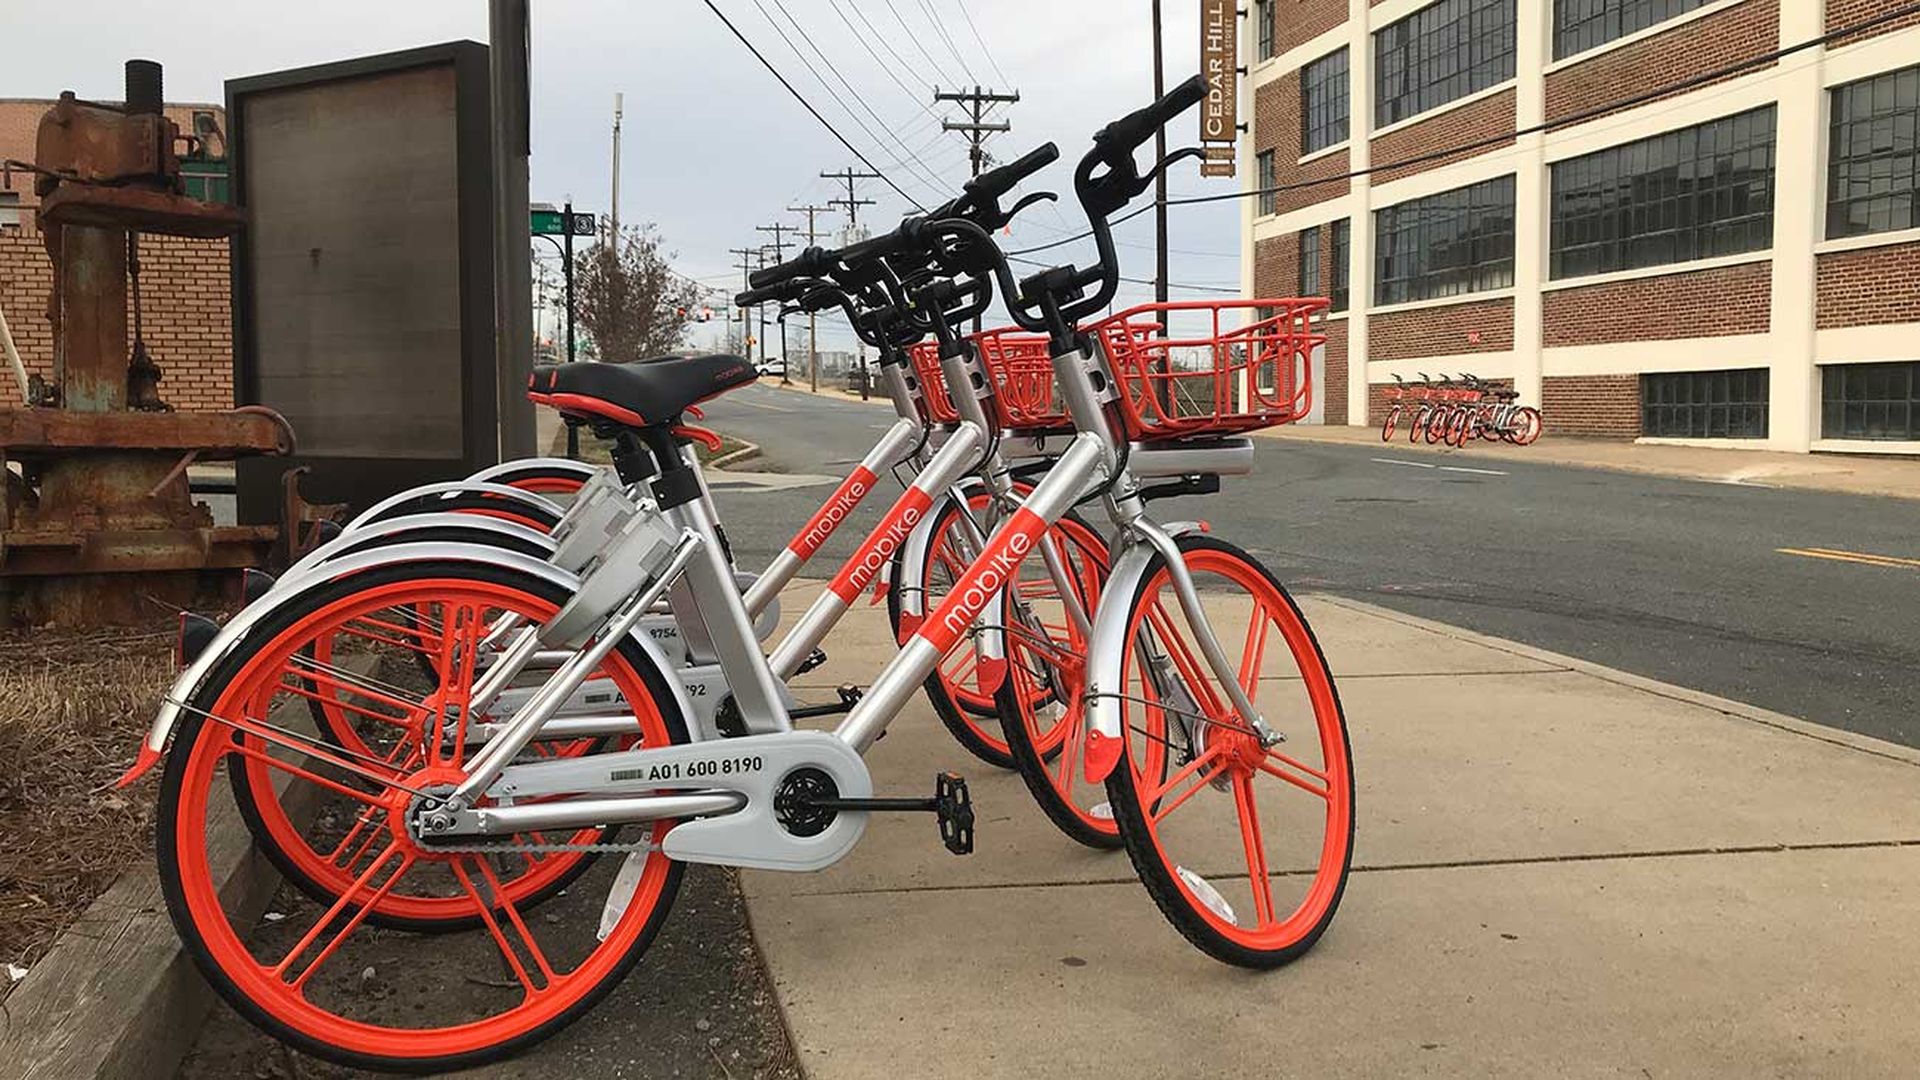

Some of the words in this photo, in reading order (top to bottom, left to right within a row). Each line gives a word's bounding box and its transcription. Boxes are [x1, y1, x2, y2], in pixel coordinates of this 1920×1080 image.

[1207, 2, 1222, 51] HILL
[1206, 58, 1222, 136] CEDAR
[804, 480, 866, 550] mobike
[849, 506, 921, 590] mobike
[943, 531, 1031, 634] mobike
[648, 763, 680, 780] A01
[687, 760, 717, 777] 600
[722, 756, 762, 774] 8190
